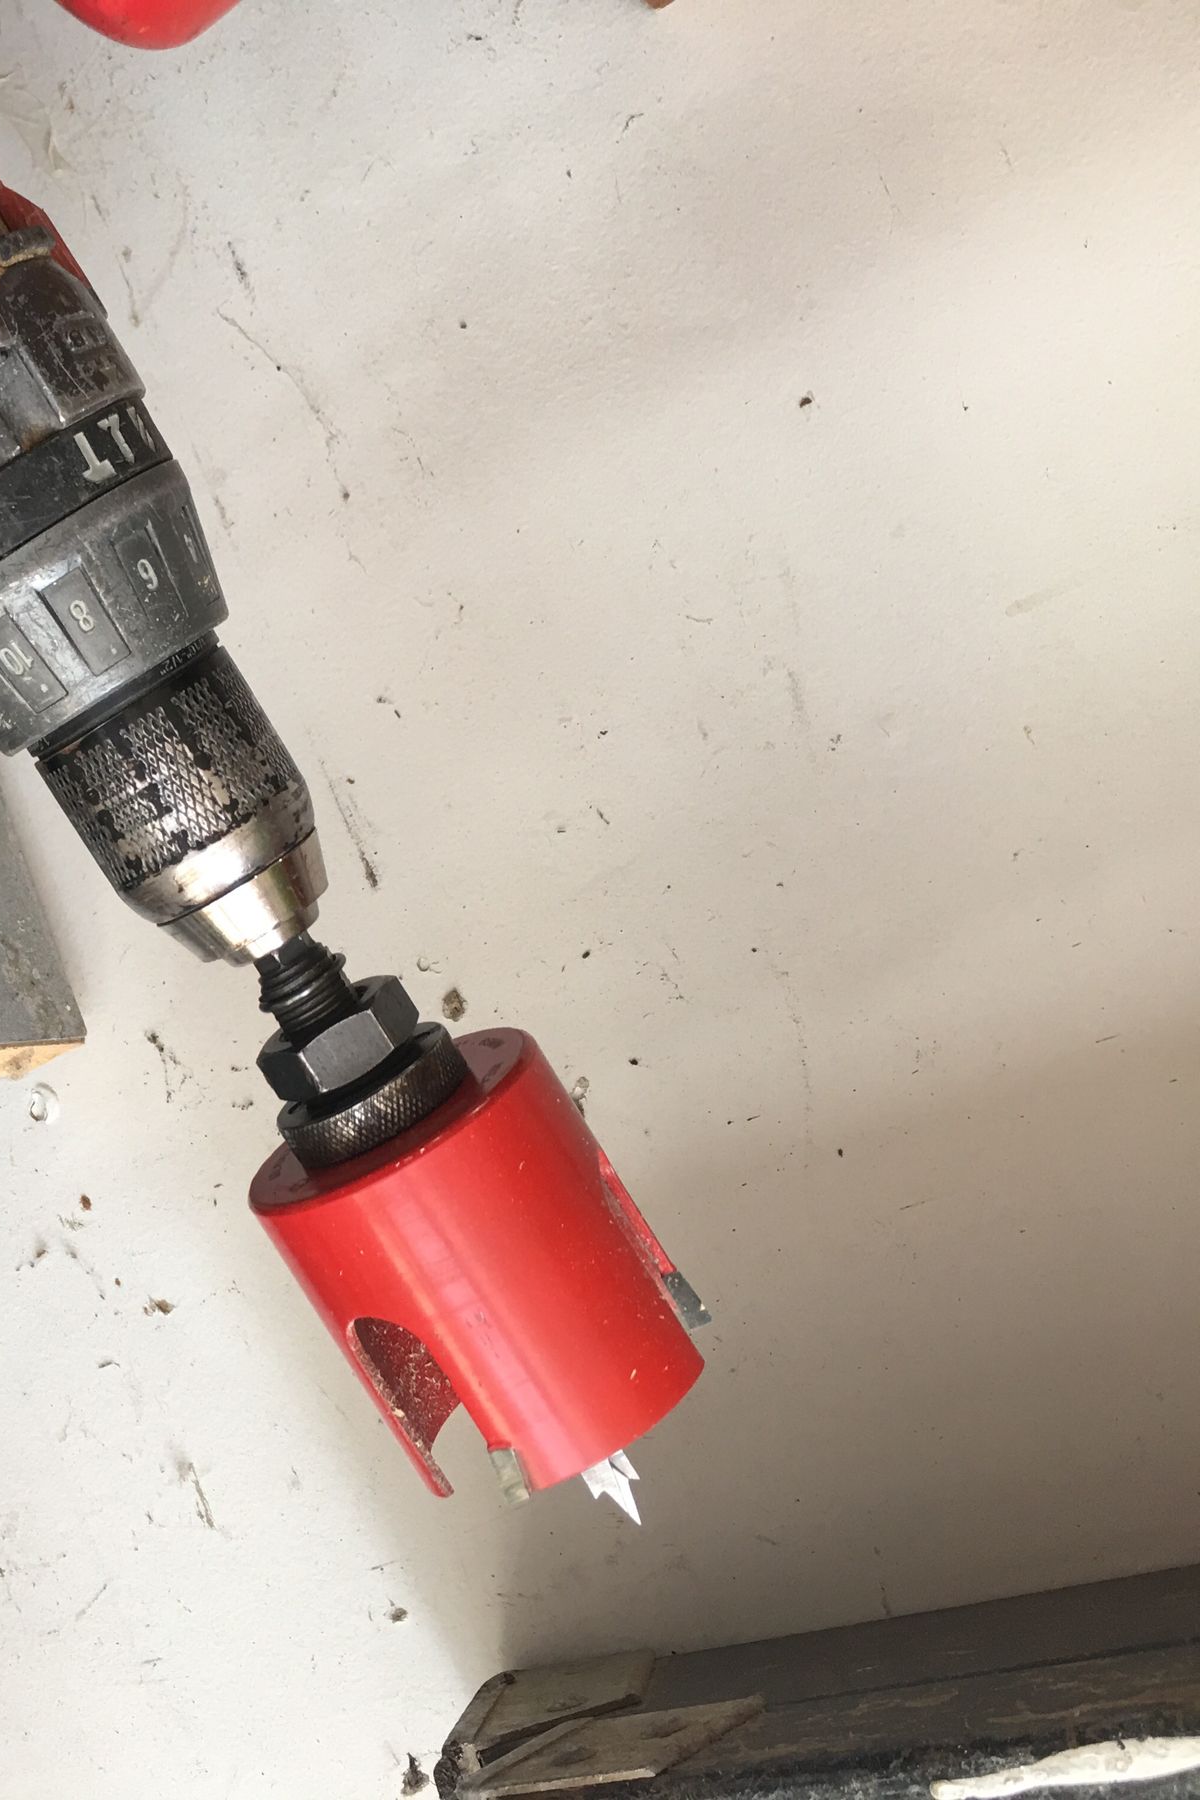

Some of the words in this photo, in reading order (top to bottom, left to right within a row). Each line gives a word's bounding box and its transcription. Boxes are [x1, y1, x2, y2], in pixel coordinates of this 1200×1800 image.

[137, 558, 159, 591] 6
[69, 600, 95, 632] 8
[0, 640, 34, 676] 10
